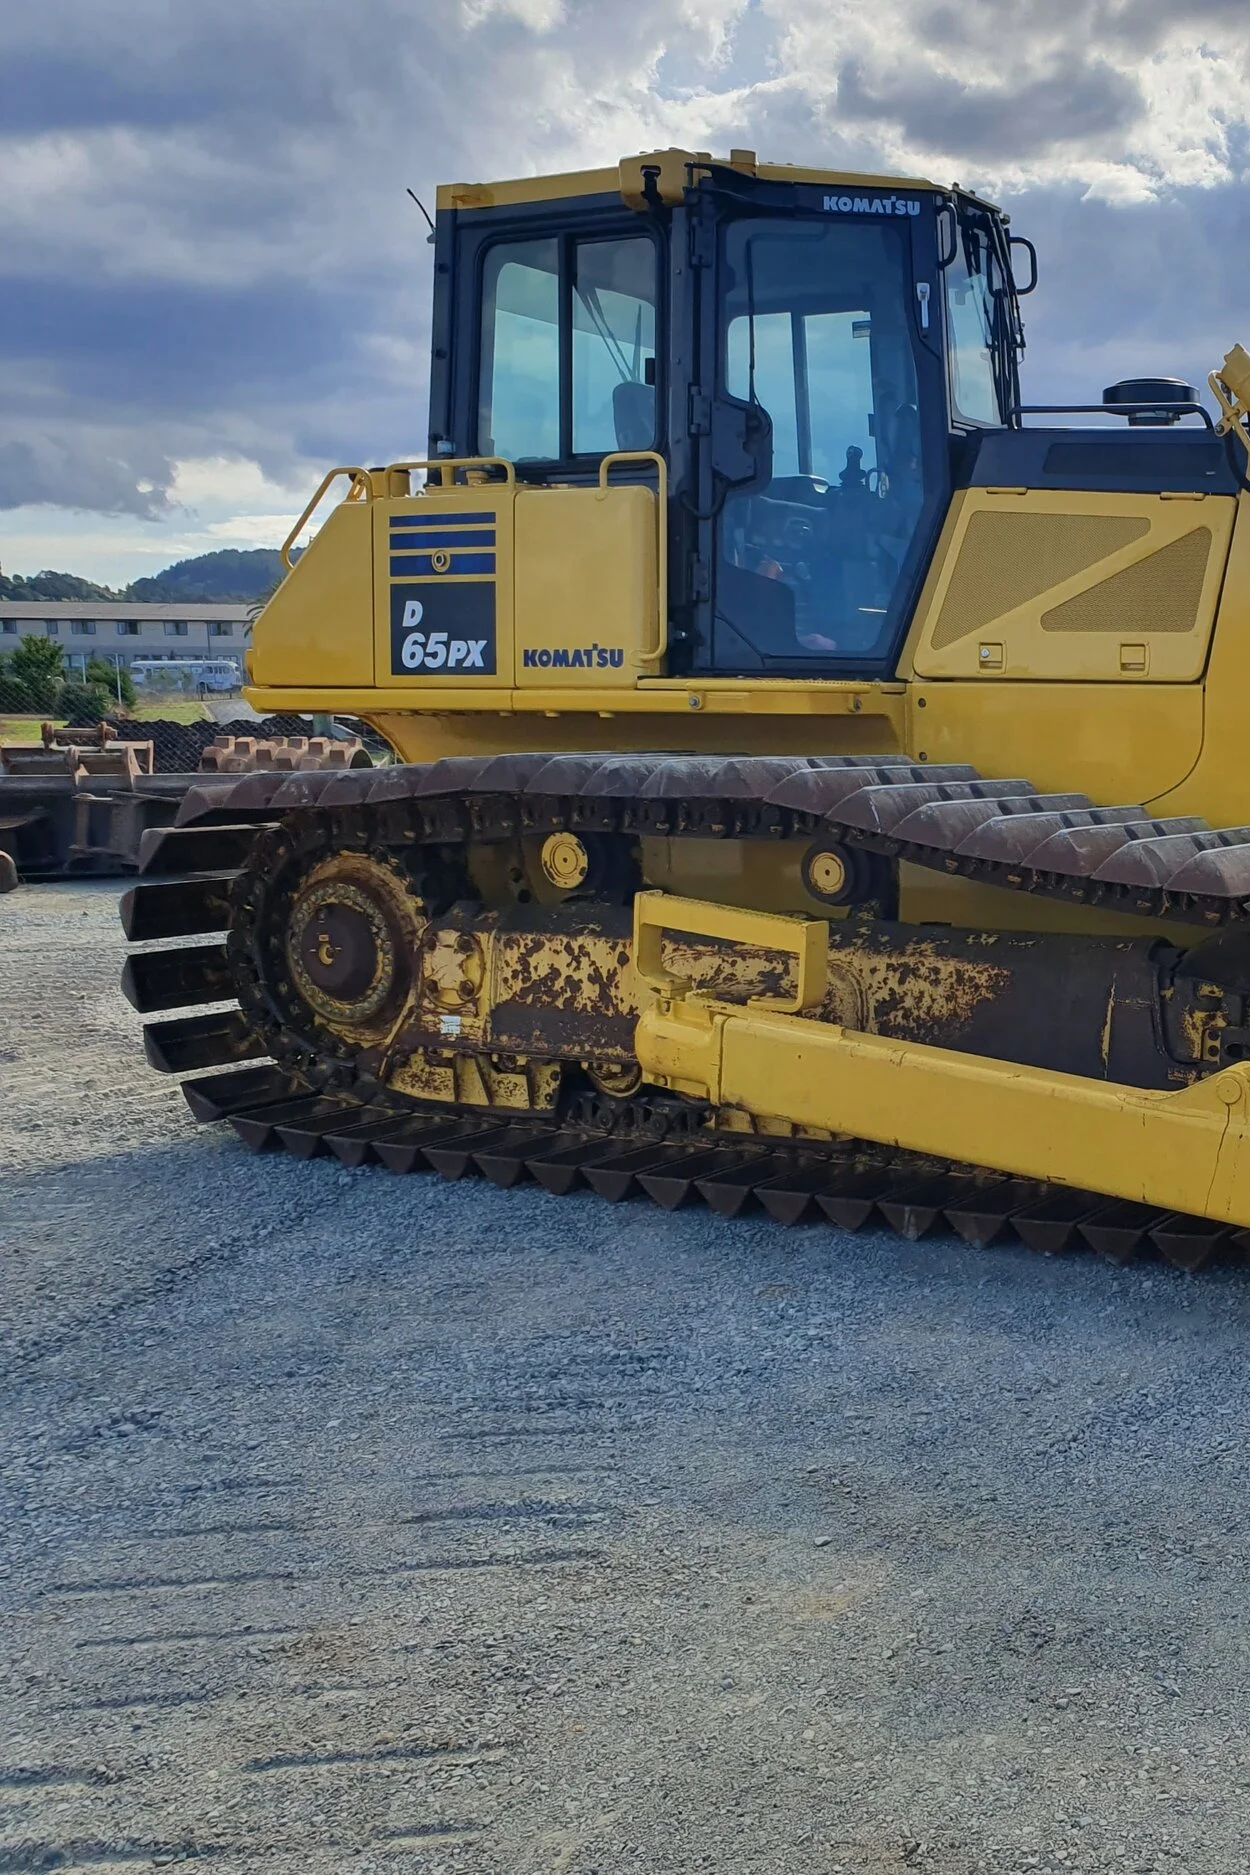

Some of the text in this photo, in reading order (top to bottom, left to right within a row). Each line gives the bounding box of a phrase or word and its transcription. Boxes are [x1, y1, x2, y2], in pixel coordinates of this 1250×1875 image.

[823, 195, 921, 216] KOMATSU
[402, 600, 424, 628] D
[401, 632, 487, 668] 65PX
[523, 643, 624, 668] KOMATSU
